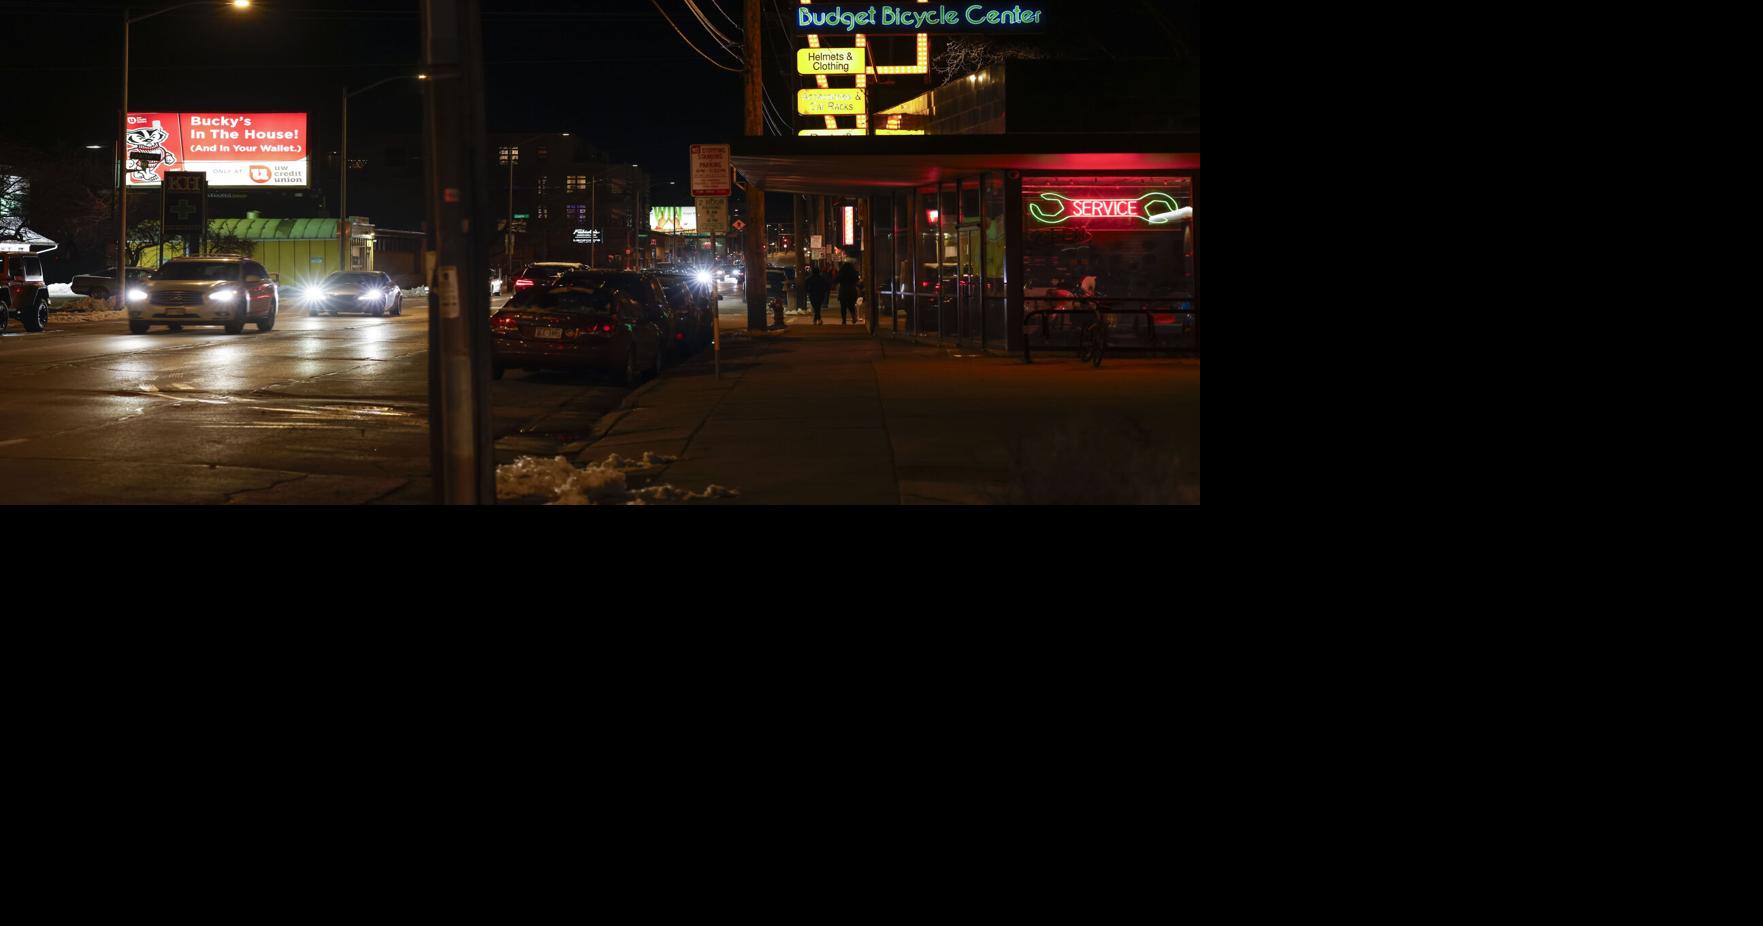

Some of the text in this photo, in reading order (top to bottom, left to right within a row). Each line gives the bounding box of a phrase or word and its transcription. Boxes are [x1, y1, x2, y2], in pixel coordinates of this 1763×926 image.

[799, 4, 1042, 32] Budget Bicycle Center
[808, 51, 853, 61] Helmets &
[812, 61, 849, 73] Clothing
[190, 116, 252, 128] Bucky's
[190, 129, 299, 139] In The House!
[190, 144, 217, 153] (And
[260, 144, 302, 153] Wallet.)
[1073, 201, 1137, 216] SERVICE
